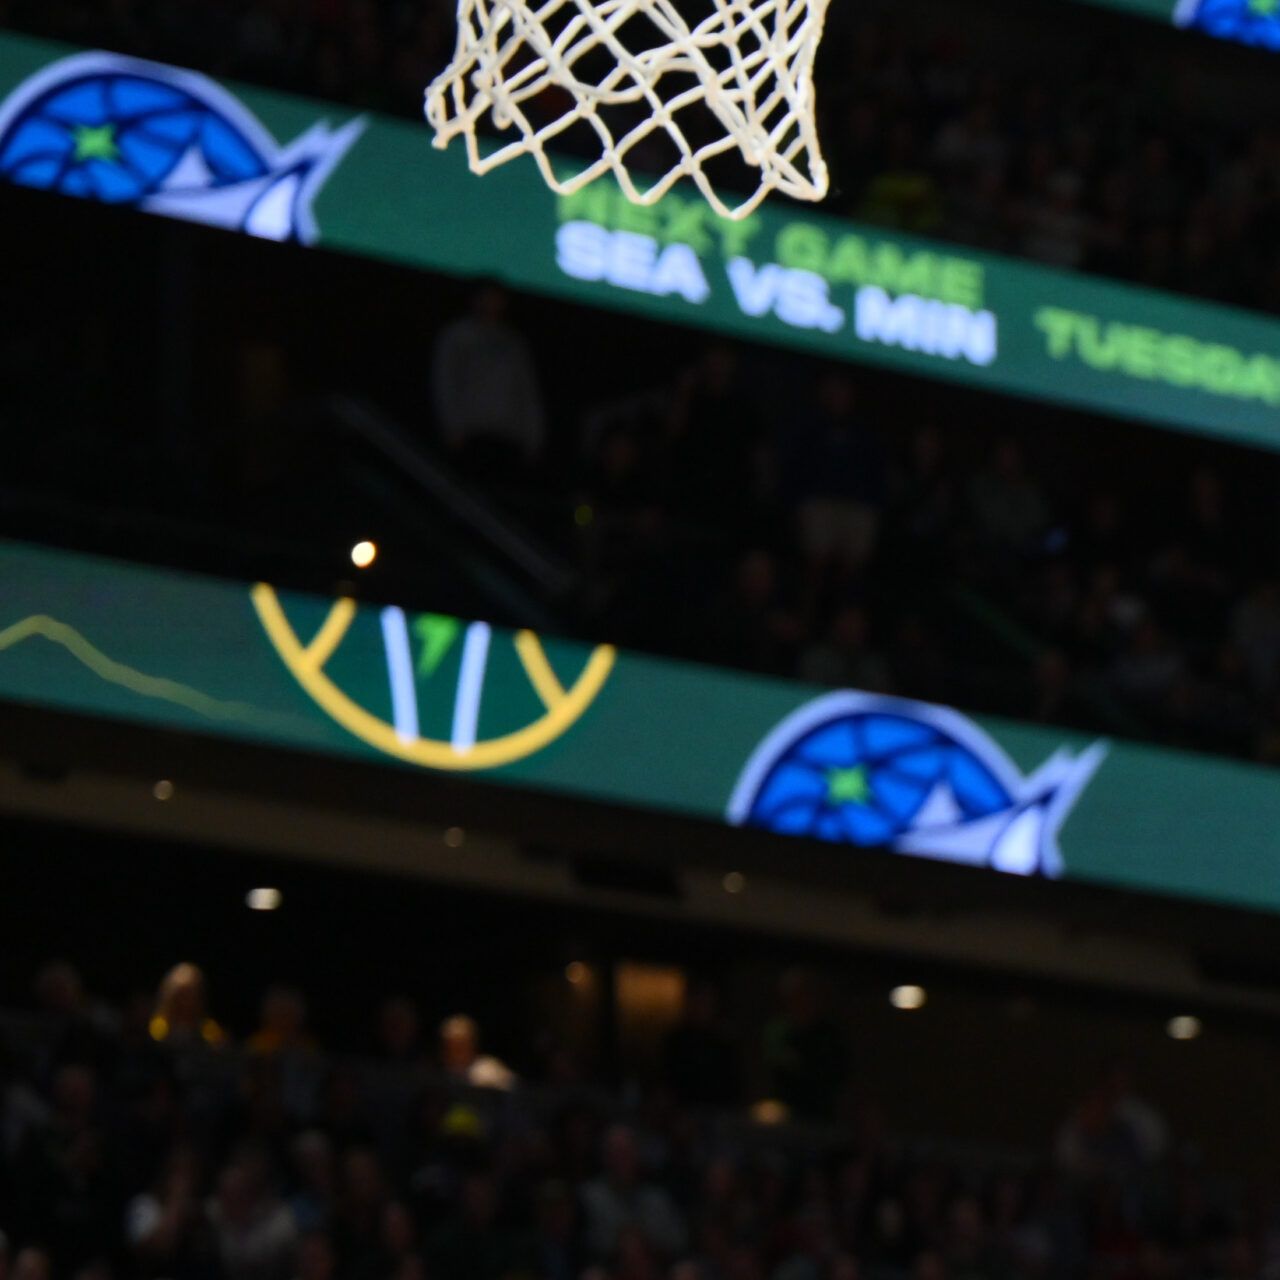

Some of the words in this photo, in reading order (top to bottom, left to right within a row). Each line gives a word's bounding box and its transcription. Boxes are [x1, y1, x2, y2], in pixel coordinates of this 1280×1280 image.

[555, 219, 711, 304] SEA
[725, 256, 845, 334] VS.
[855, 285, 998, 366] MIN
[775, 221, 986, 308] GAME
